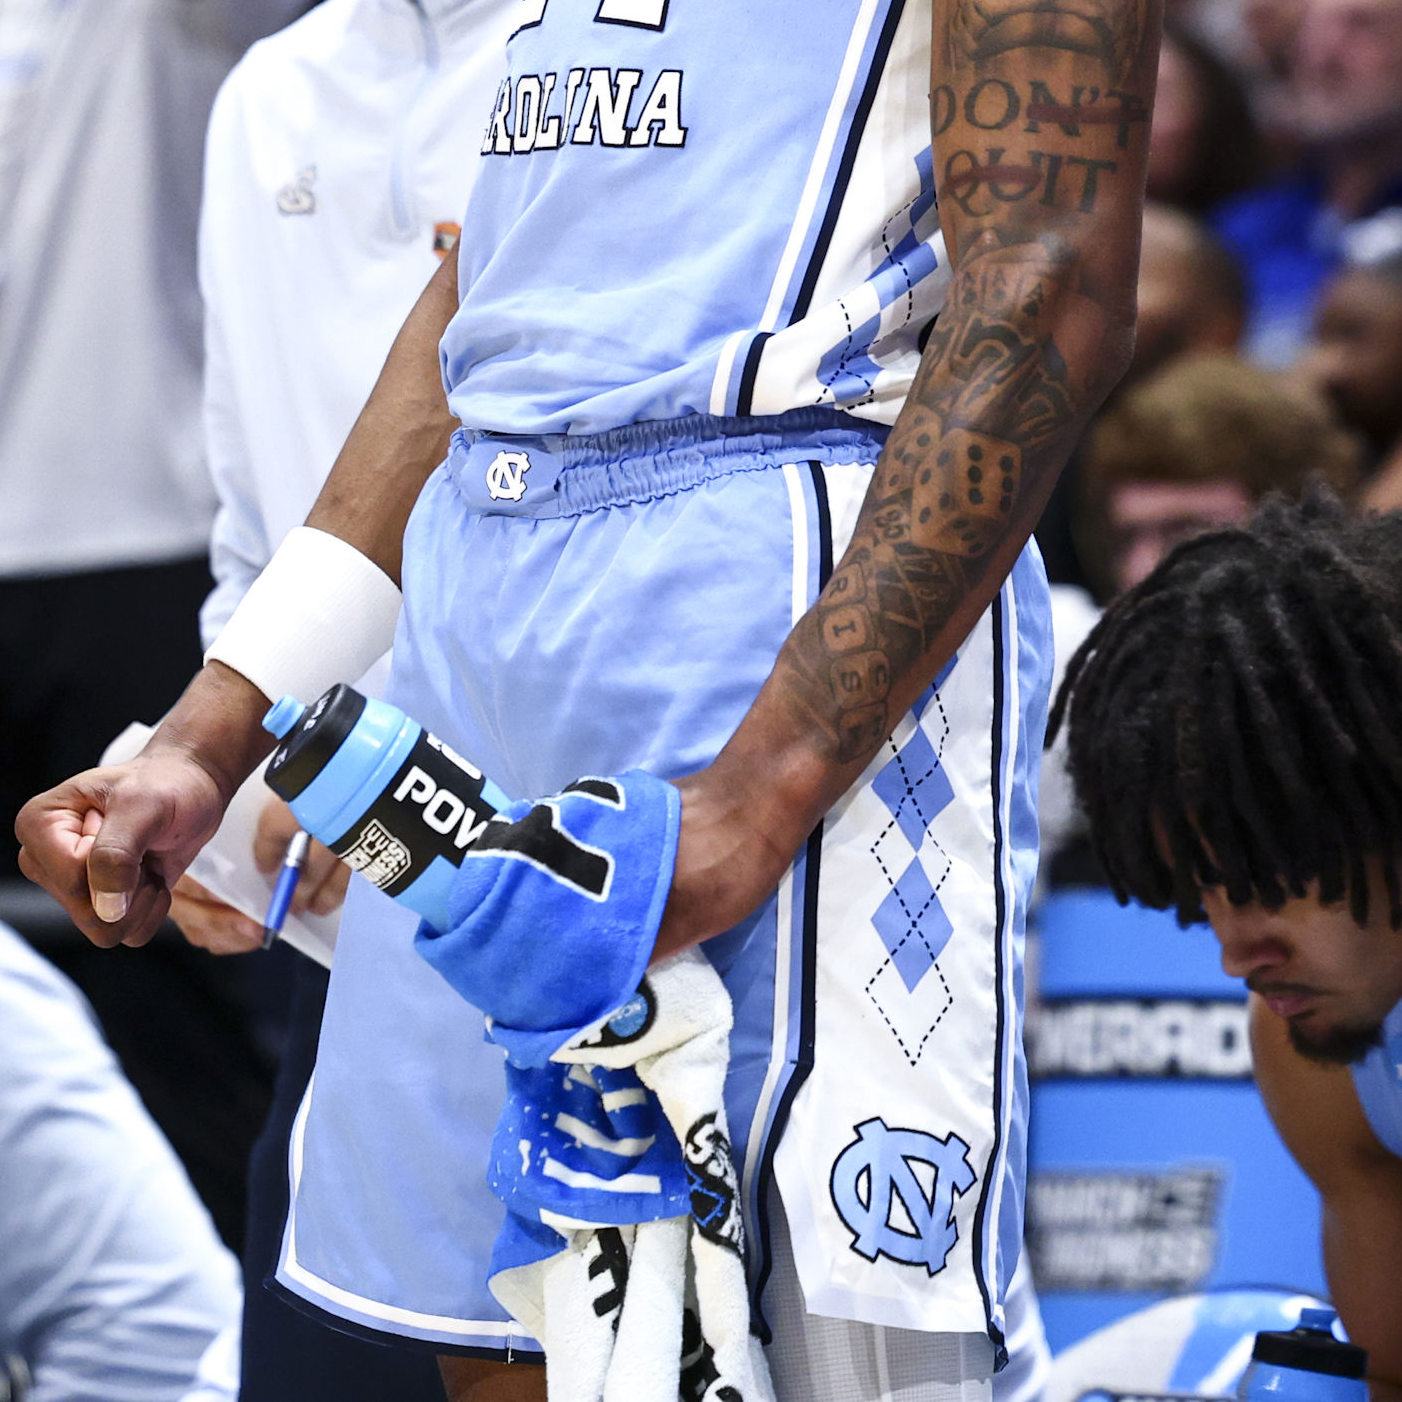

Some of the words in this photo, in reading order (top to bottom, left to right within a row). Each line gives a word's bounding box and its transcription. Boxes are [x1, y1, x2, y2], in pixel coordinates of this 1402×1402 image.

[480, 67, 689, 157] ROLINA
[928, 78, 1152, 149] DON'T
[944, 147, 1118, 218] QUIT
